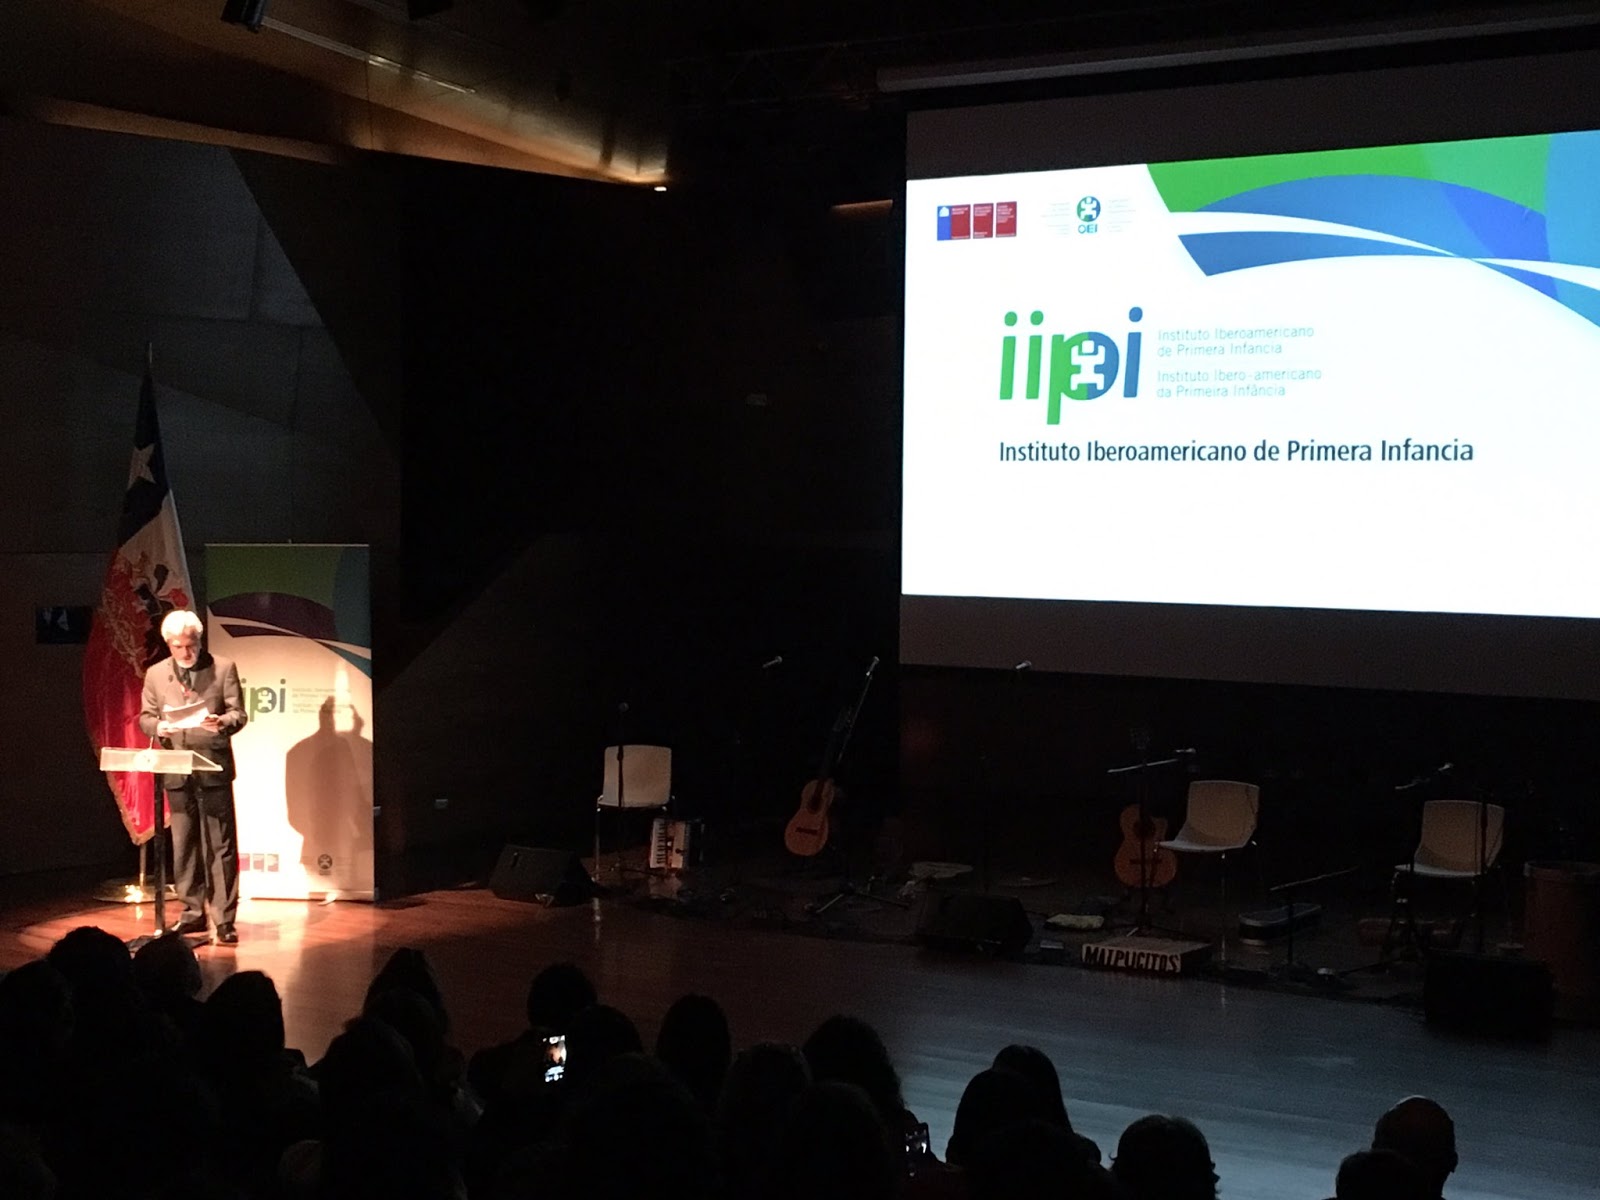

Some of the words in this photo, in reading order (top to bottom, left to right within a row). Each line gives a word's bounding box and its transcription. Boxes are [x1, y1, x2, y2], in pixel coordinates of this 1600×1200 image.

[1078, 223, 1098, 235] OEI
[1158, 329, 1210, 341] Instituto
[1215, 327, 1314, 340] Iberoamericano
[1157, 346, 1172, 357] de
[1177, 344, 1225, 356] Primera
[1230, 342, 1282, 355] Infancia
[1157, 370, 1209, 382] Instituto
[1214, 369, 1322, 381] Ibero-americano
[1157, 387, 1172, 398] da
[1176, 385, 1228, 397] Primeira
[1233, 384, 1285, 397] Infância
[999, 440, 1080, 462] Instituto
[1087, 439, 1247, 462] Iberoamericano
[1253, 439, 1280, 462] de
[1287, 438, 1372, 462] Primera
[1381, 438, 1474, 462] Infancia
